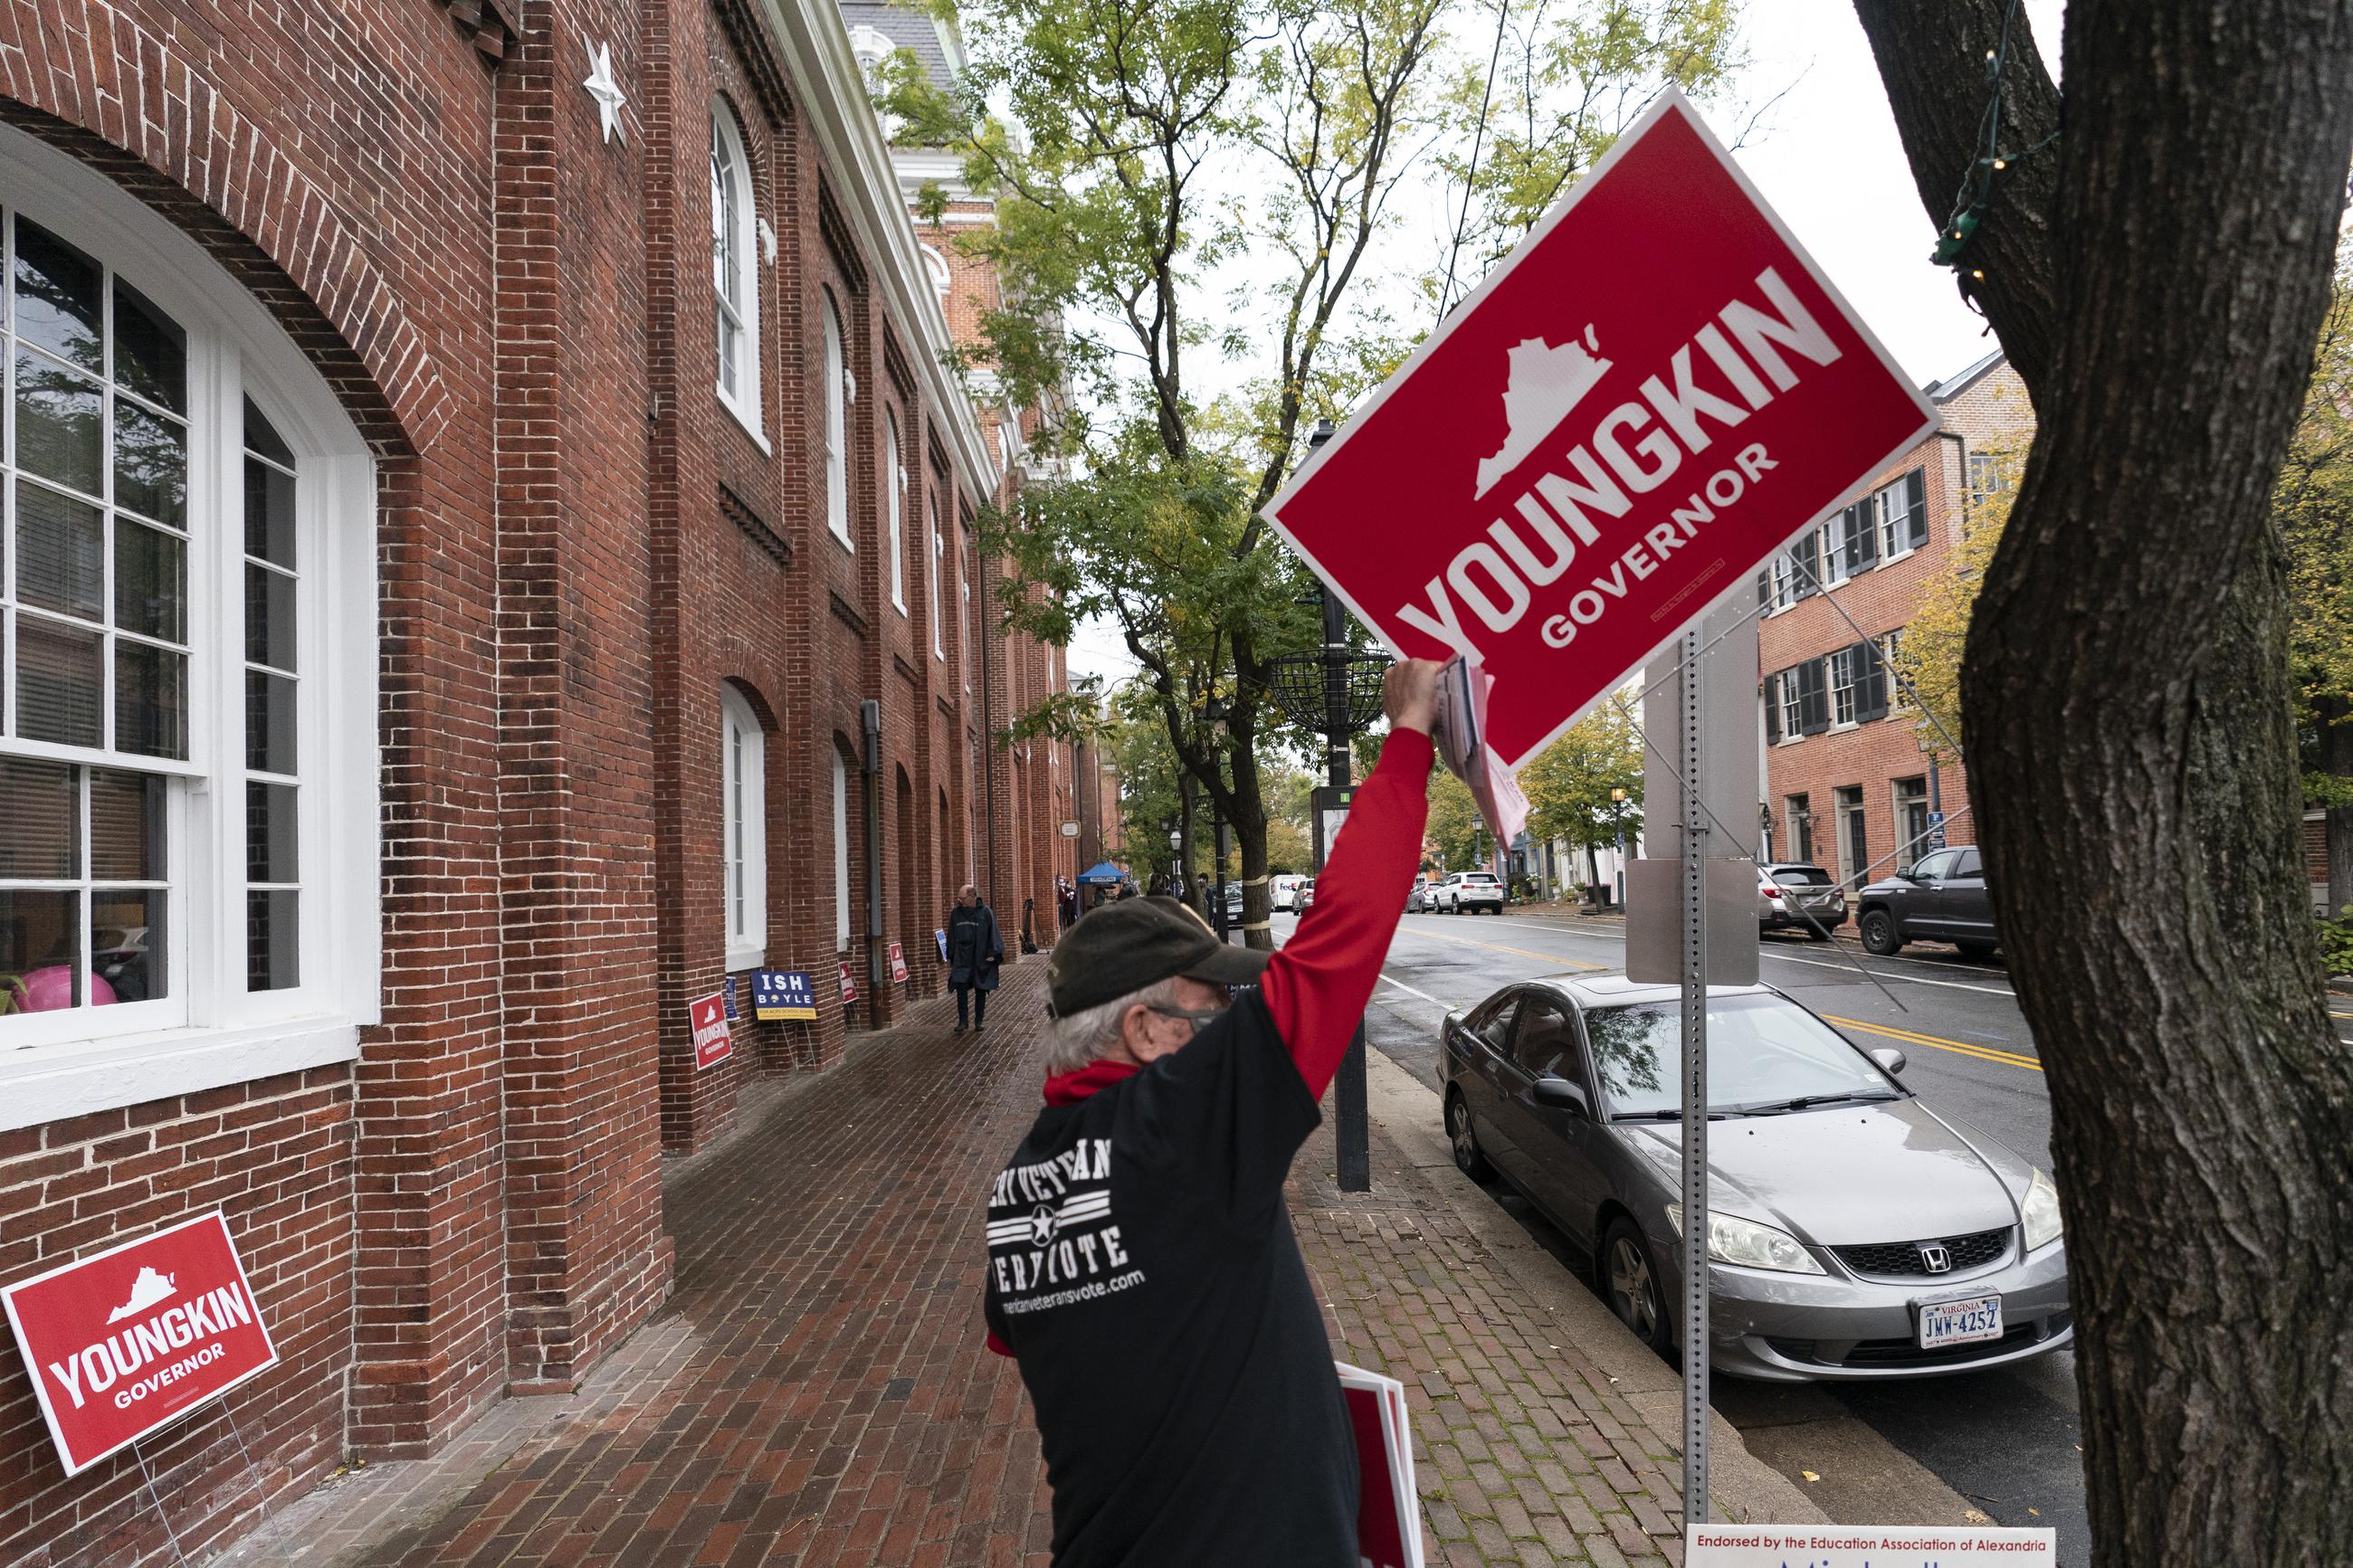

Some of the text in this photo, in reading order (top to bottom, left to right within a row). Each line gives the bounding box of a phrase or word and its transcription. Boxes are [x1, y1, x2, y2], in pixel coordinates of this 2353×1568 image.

[1396, 266, 1843, 668] YOUNGKIN
[1540, 442, 1779, 649] GOVERNOR
[761, 974, 803, 991] ISH
[1926, 1309, 1996, 1337] JMW-4252
[1941, 1301, 1980, 1314] VIRGINIA
[48, 1280, 252, 1411] YOUNGKIN
[114, 1343, 225, 1409] GOVERNOR
[1697, 1535, 2046, 1552] Endorsed by the Education Association of Alexandria
